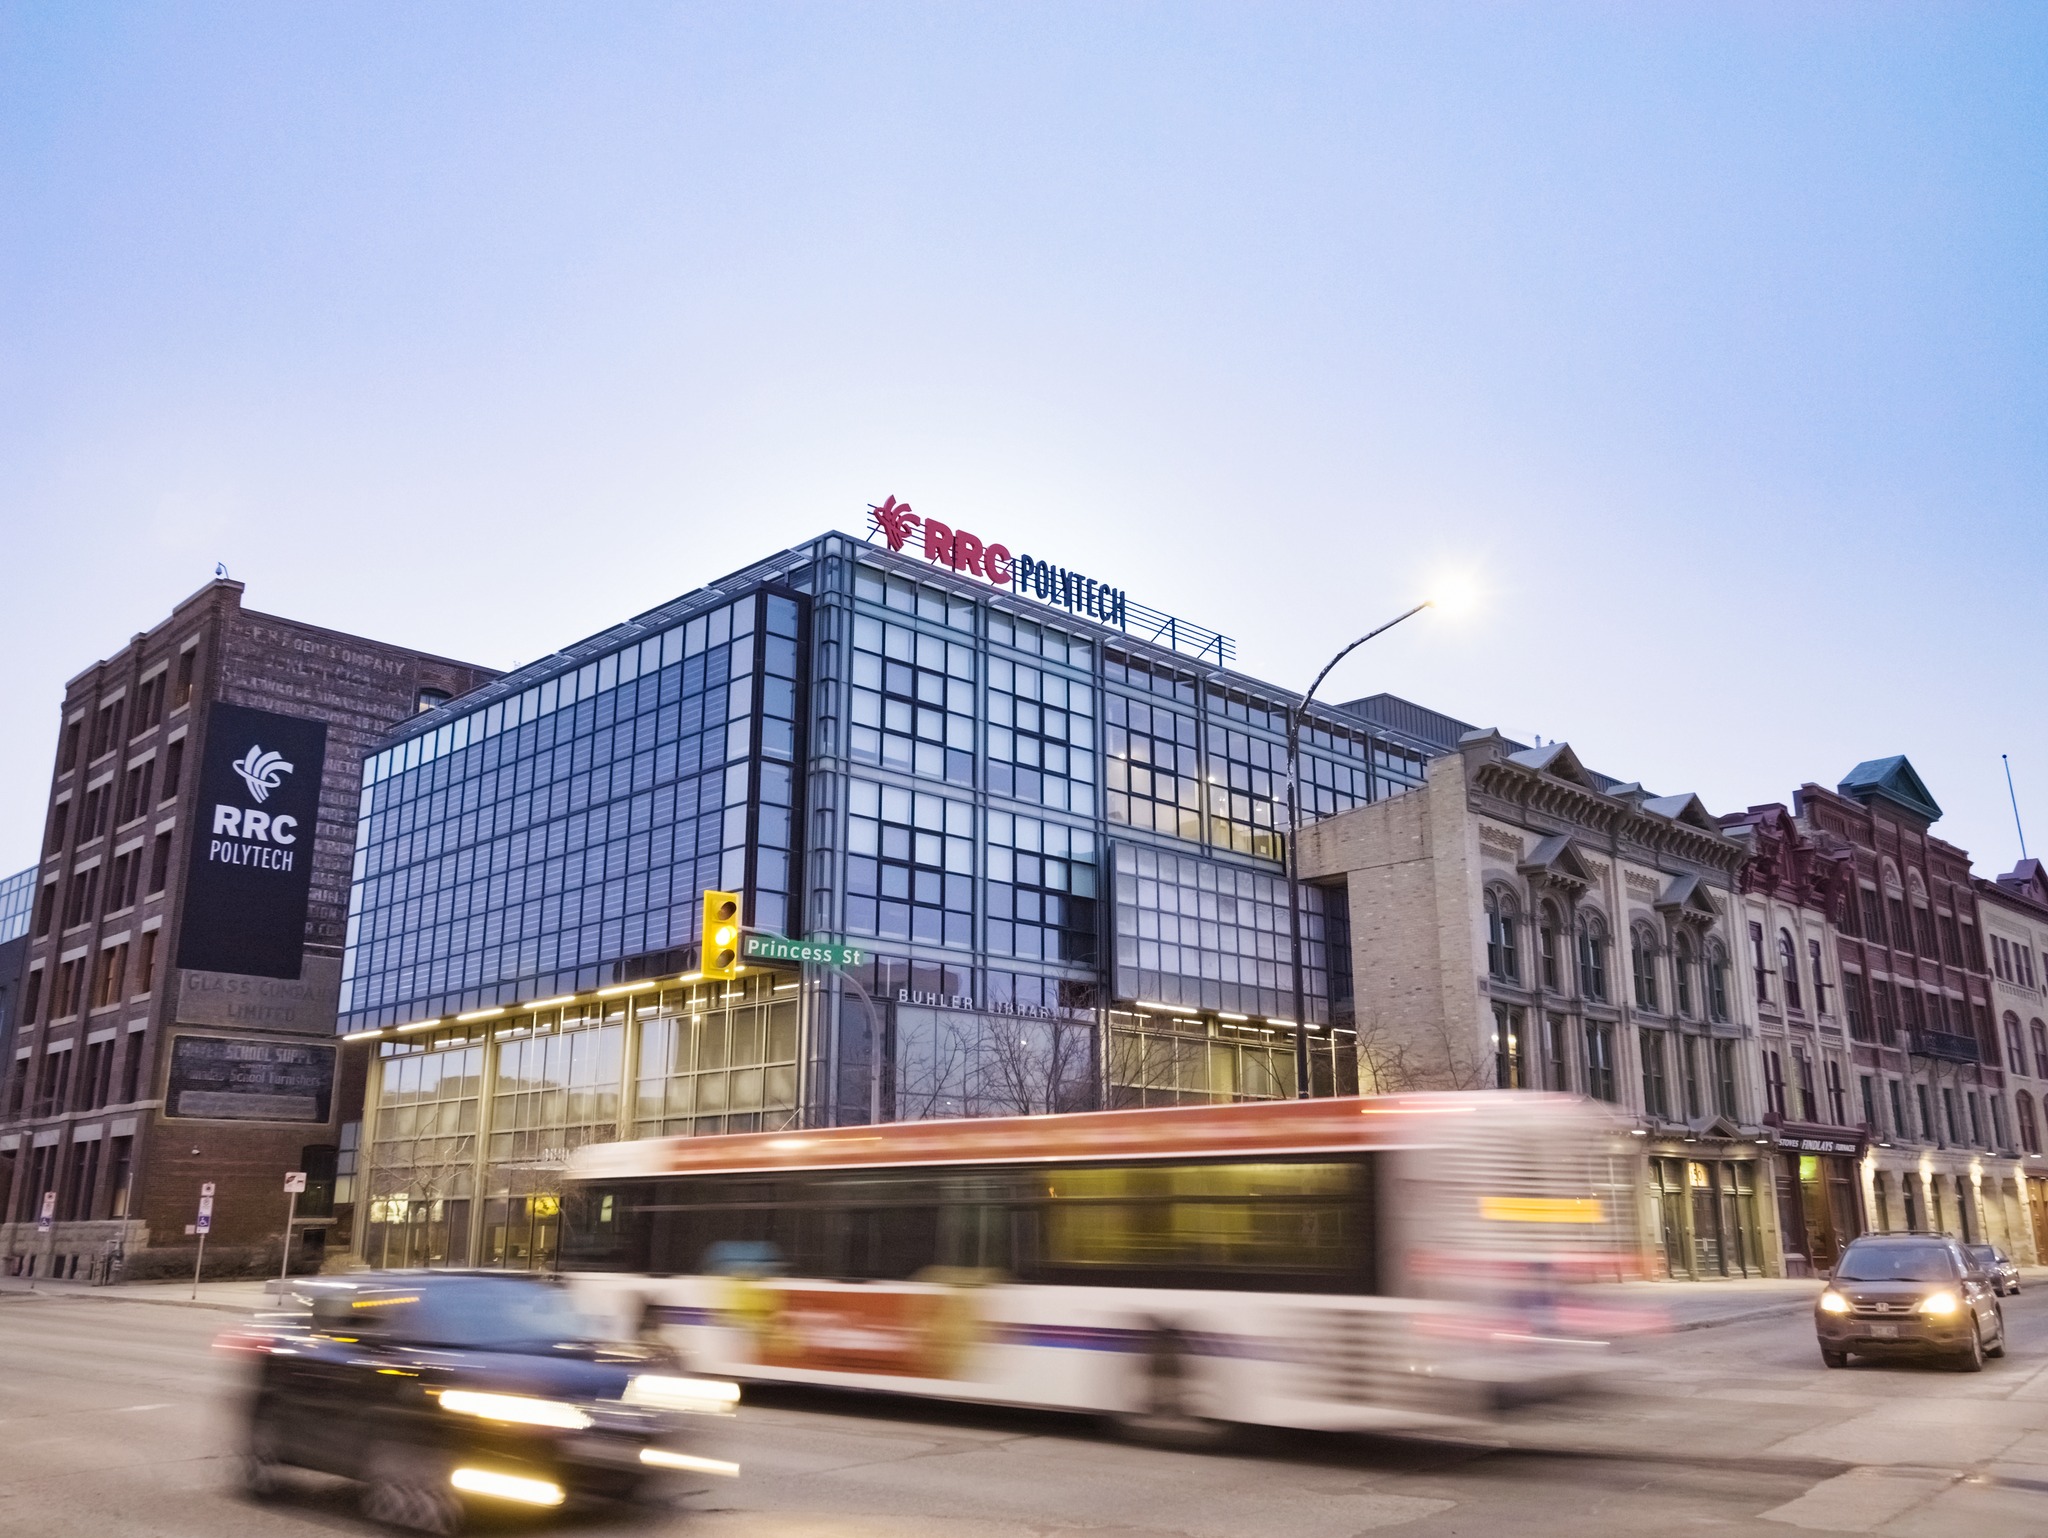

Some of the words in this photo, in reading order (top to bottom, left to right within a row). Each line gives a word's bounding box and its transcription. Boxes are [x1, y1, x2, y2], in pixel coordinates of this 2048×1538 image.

[924, 517, 1012, 585] RRC
[1021, 554, 1126, 628] POLYTECH
[213, 804, 298, 845] RRC
[209, 839, 294, 872] POLYTECH
[747, 939, 832, 962] Princess
[842, 949, 860, 965] St
[188, 973, 251, 995] GLASS
[899, 988, 973, 1010] BUHLER
[225, 1044, 271, 1062] SCHOOL
[1779, 1138, 1799, 1148] STOVES
[1801, 1139, 1834, 1152] FINDLAYS
